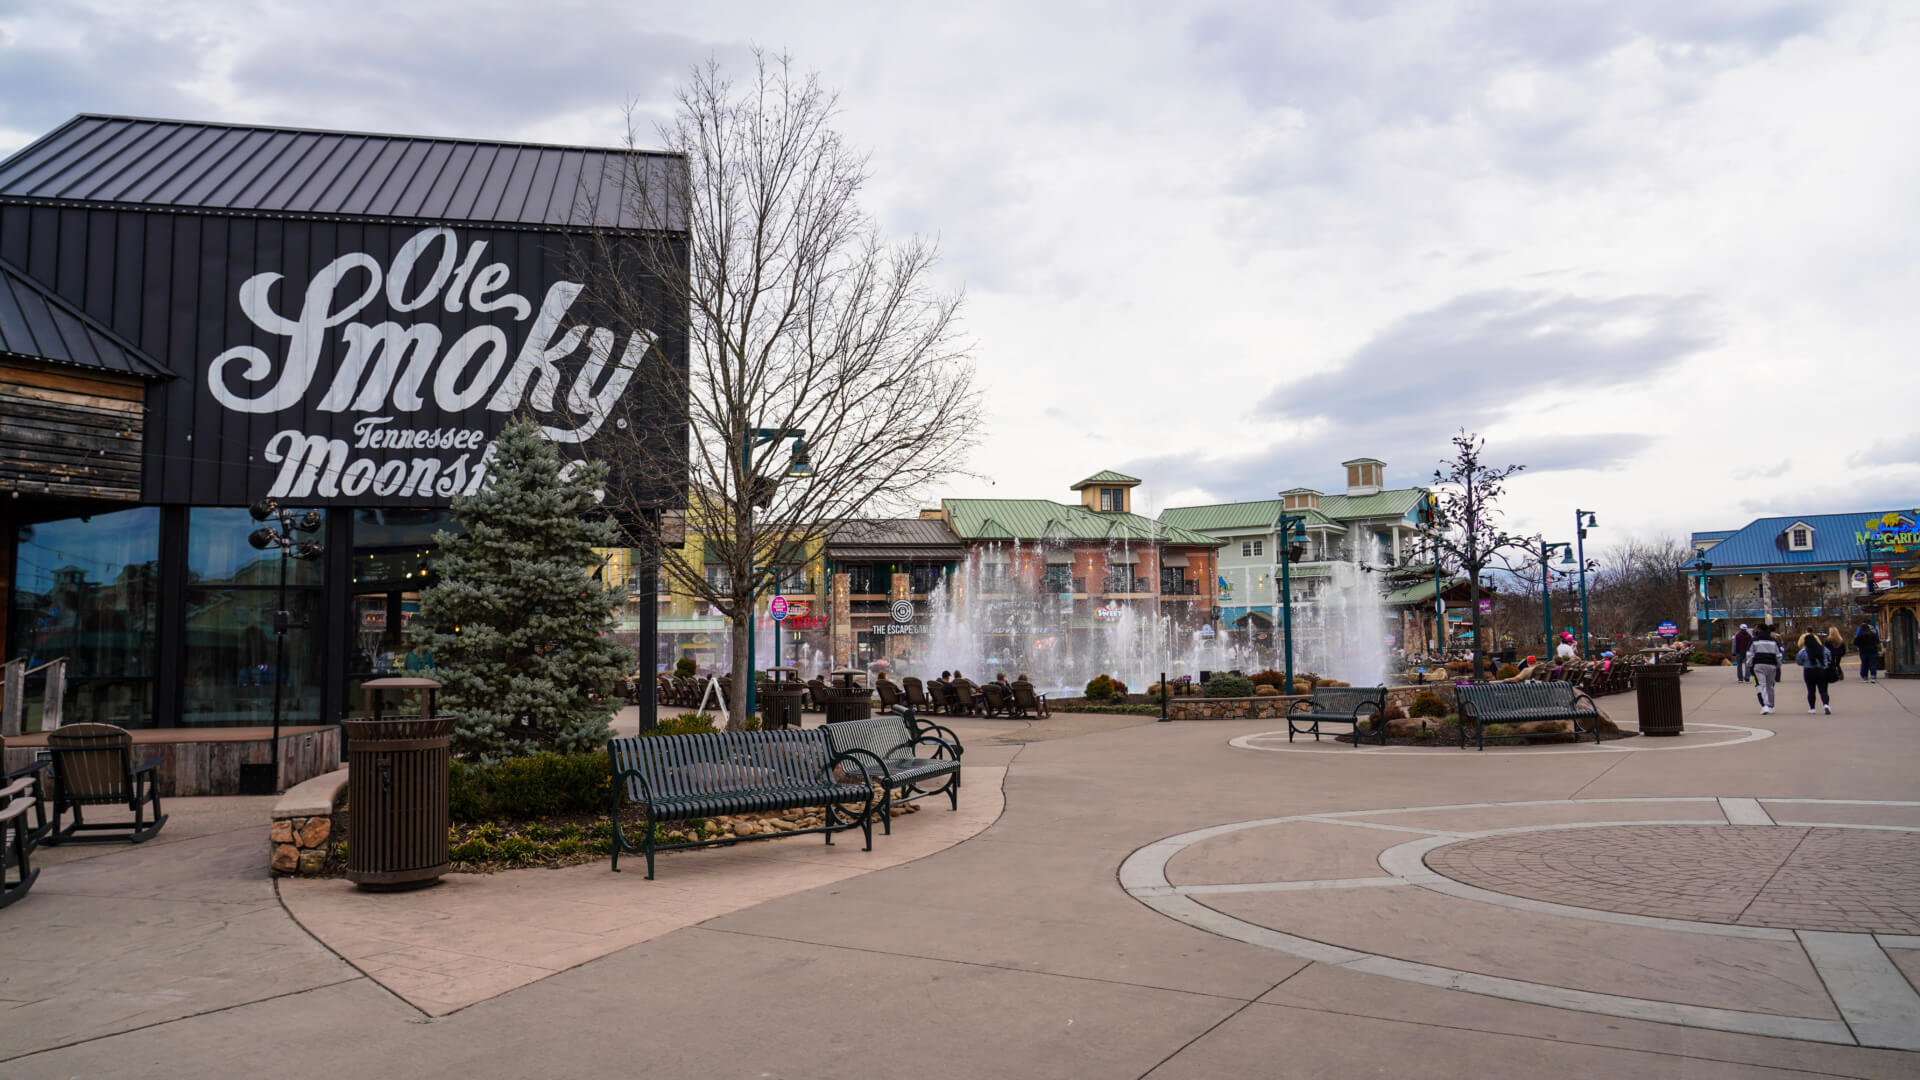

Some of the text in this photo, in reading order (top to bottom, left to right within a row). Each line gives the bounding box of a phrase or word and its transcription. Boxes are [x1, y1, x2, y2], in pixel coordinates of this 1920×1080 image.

[386, 226, 532, 321] Ole
[207, 252, 659, 444] Smoky
[354, 416, 485, 450] Tennessee
[790, 615, 828, 630] JERKY
[872, 625, 886, 635] THE
[887, 624, 914, 635] ESCAPE
